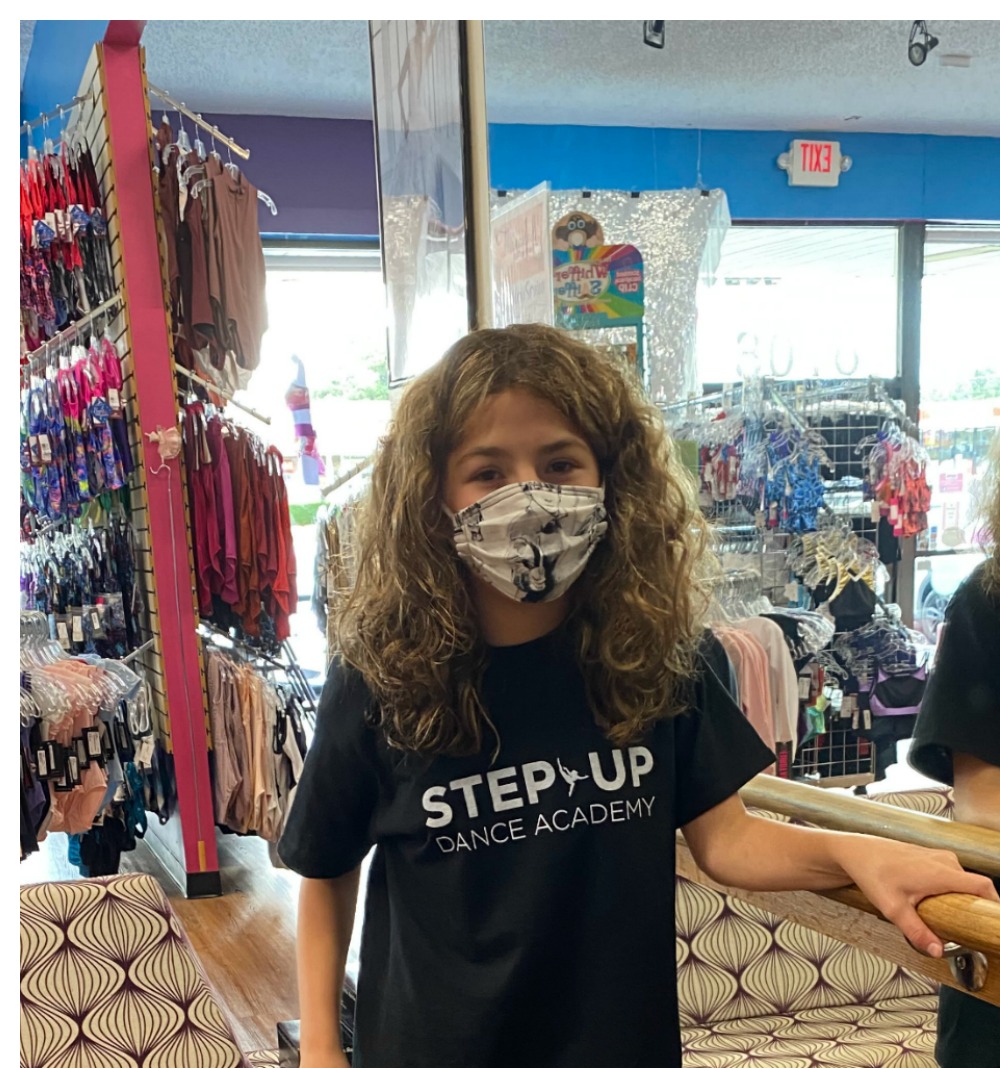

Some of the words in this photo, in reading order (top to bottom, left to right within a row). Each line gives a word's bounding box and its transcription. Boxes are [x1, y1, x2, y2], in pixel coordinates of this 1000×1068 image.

[421, 760, 557, 828] STEP
[588, 746, 655, 791] UP
[435, 817, 527, 853] DANCE
[534, 795, 656, 836] ACADEMY
